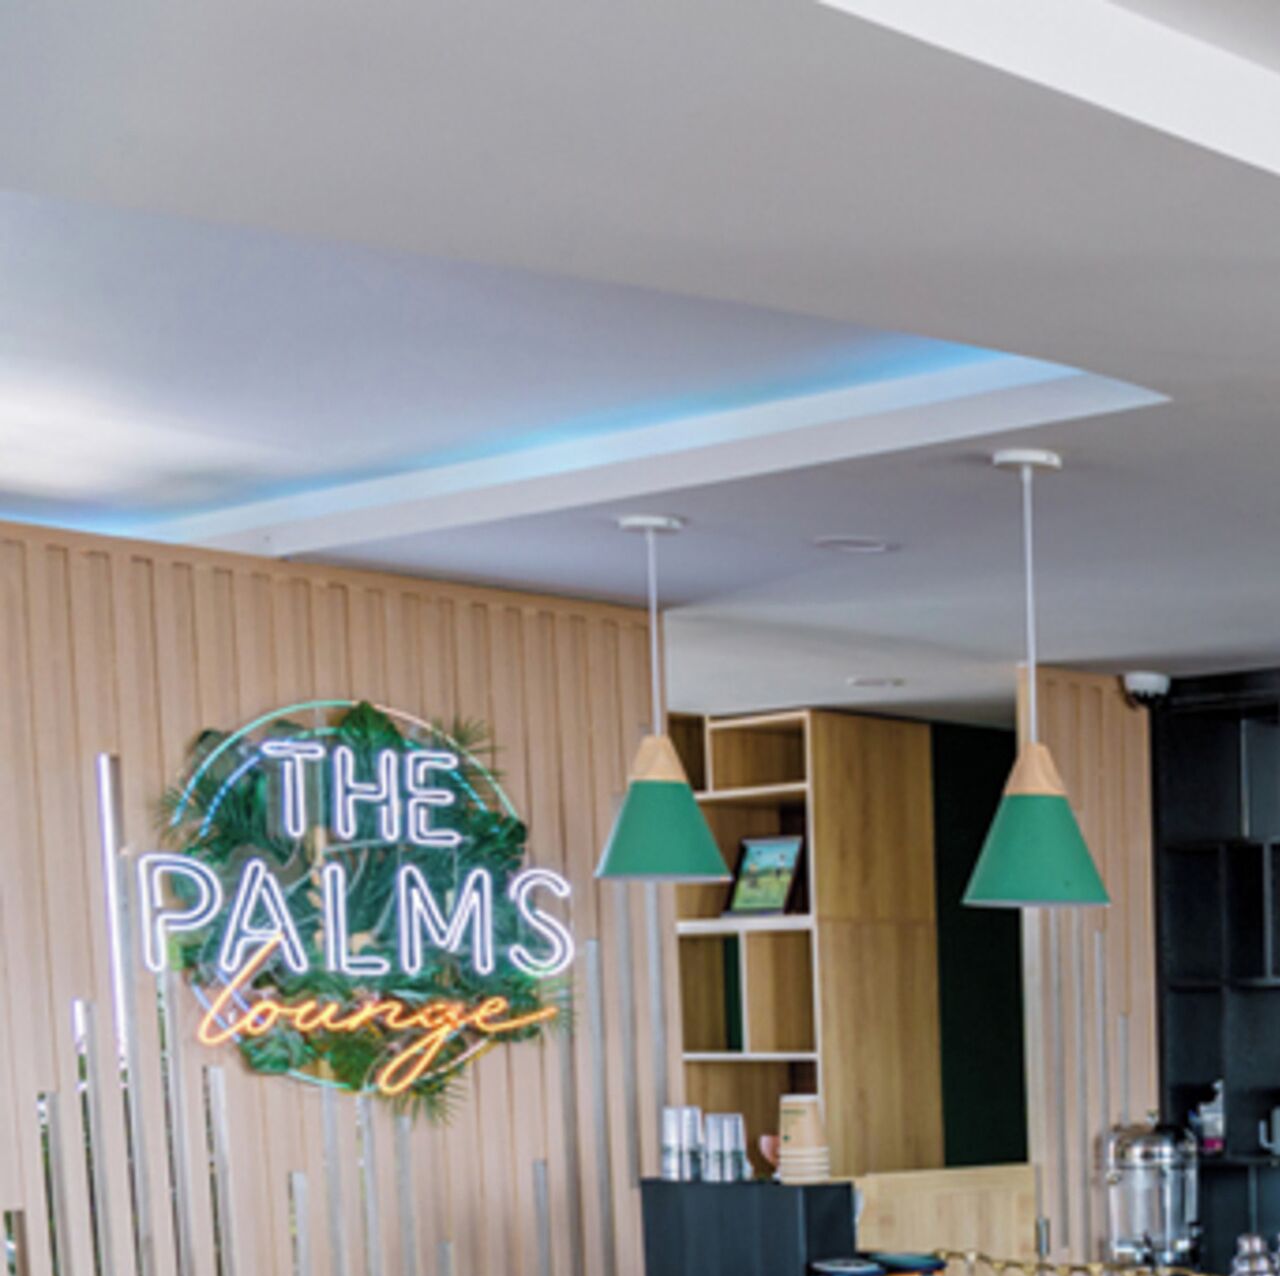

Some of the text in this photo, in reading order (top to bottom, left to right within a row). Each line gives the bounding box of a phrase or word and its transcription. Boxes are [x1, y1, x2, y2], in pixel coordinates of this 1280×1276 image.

[261, 740, 462, 846] THE
[137, 852, 576, 978] PALMS
[197, 931, 559, 1095] lounge
